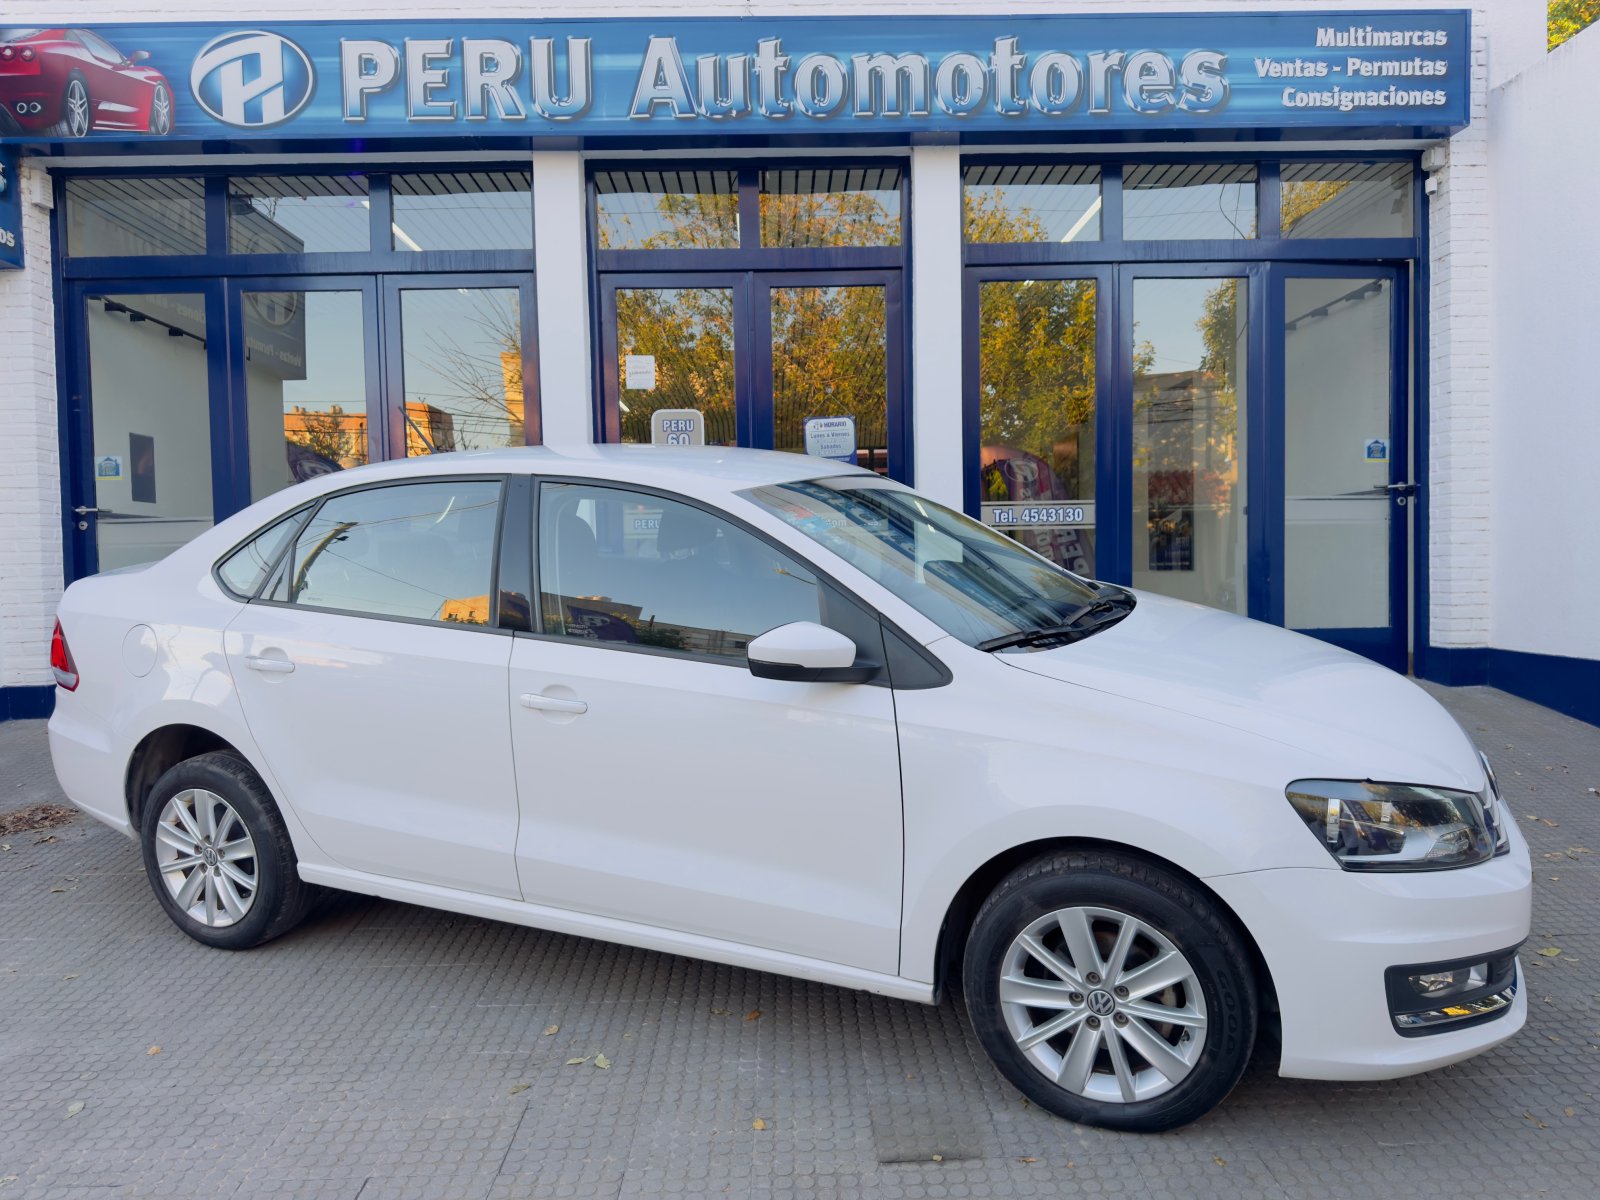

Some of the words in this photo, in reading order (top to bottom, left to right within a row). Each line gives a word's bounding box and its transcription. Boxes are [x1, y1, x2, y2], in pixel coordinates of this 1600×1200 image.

[1315, 26, 1448, 47] Multimarcas
[340, 37, 593, 122] PERU
[628, 34, 1230, 121] Automotores
[1254, 57, 1328, 78] Ventas
[1346, 57, 1448, 77] Permutas
[1281, 85, 1447, 111] Consignaciones
[663, 419, 694, 432] PERU
[993, 509, 1017, 523] Tel.
[1021, 508, 1084, 522] 4543130
